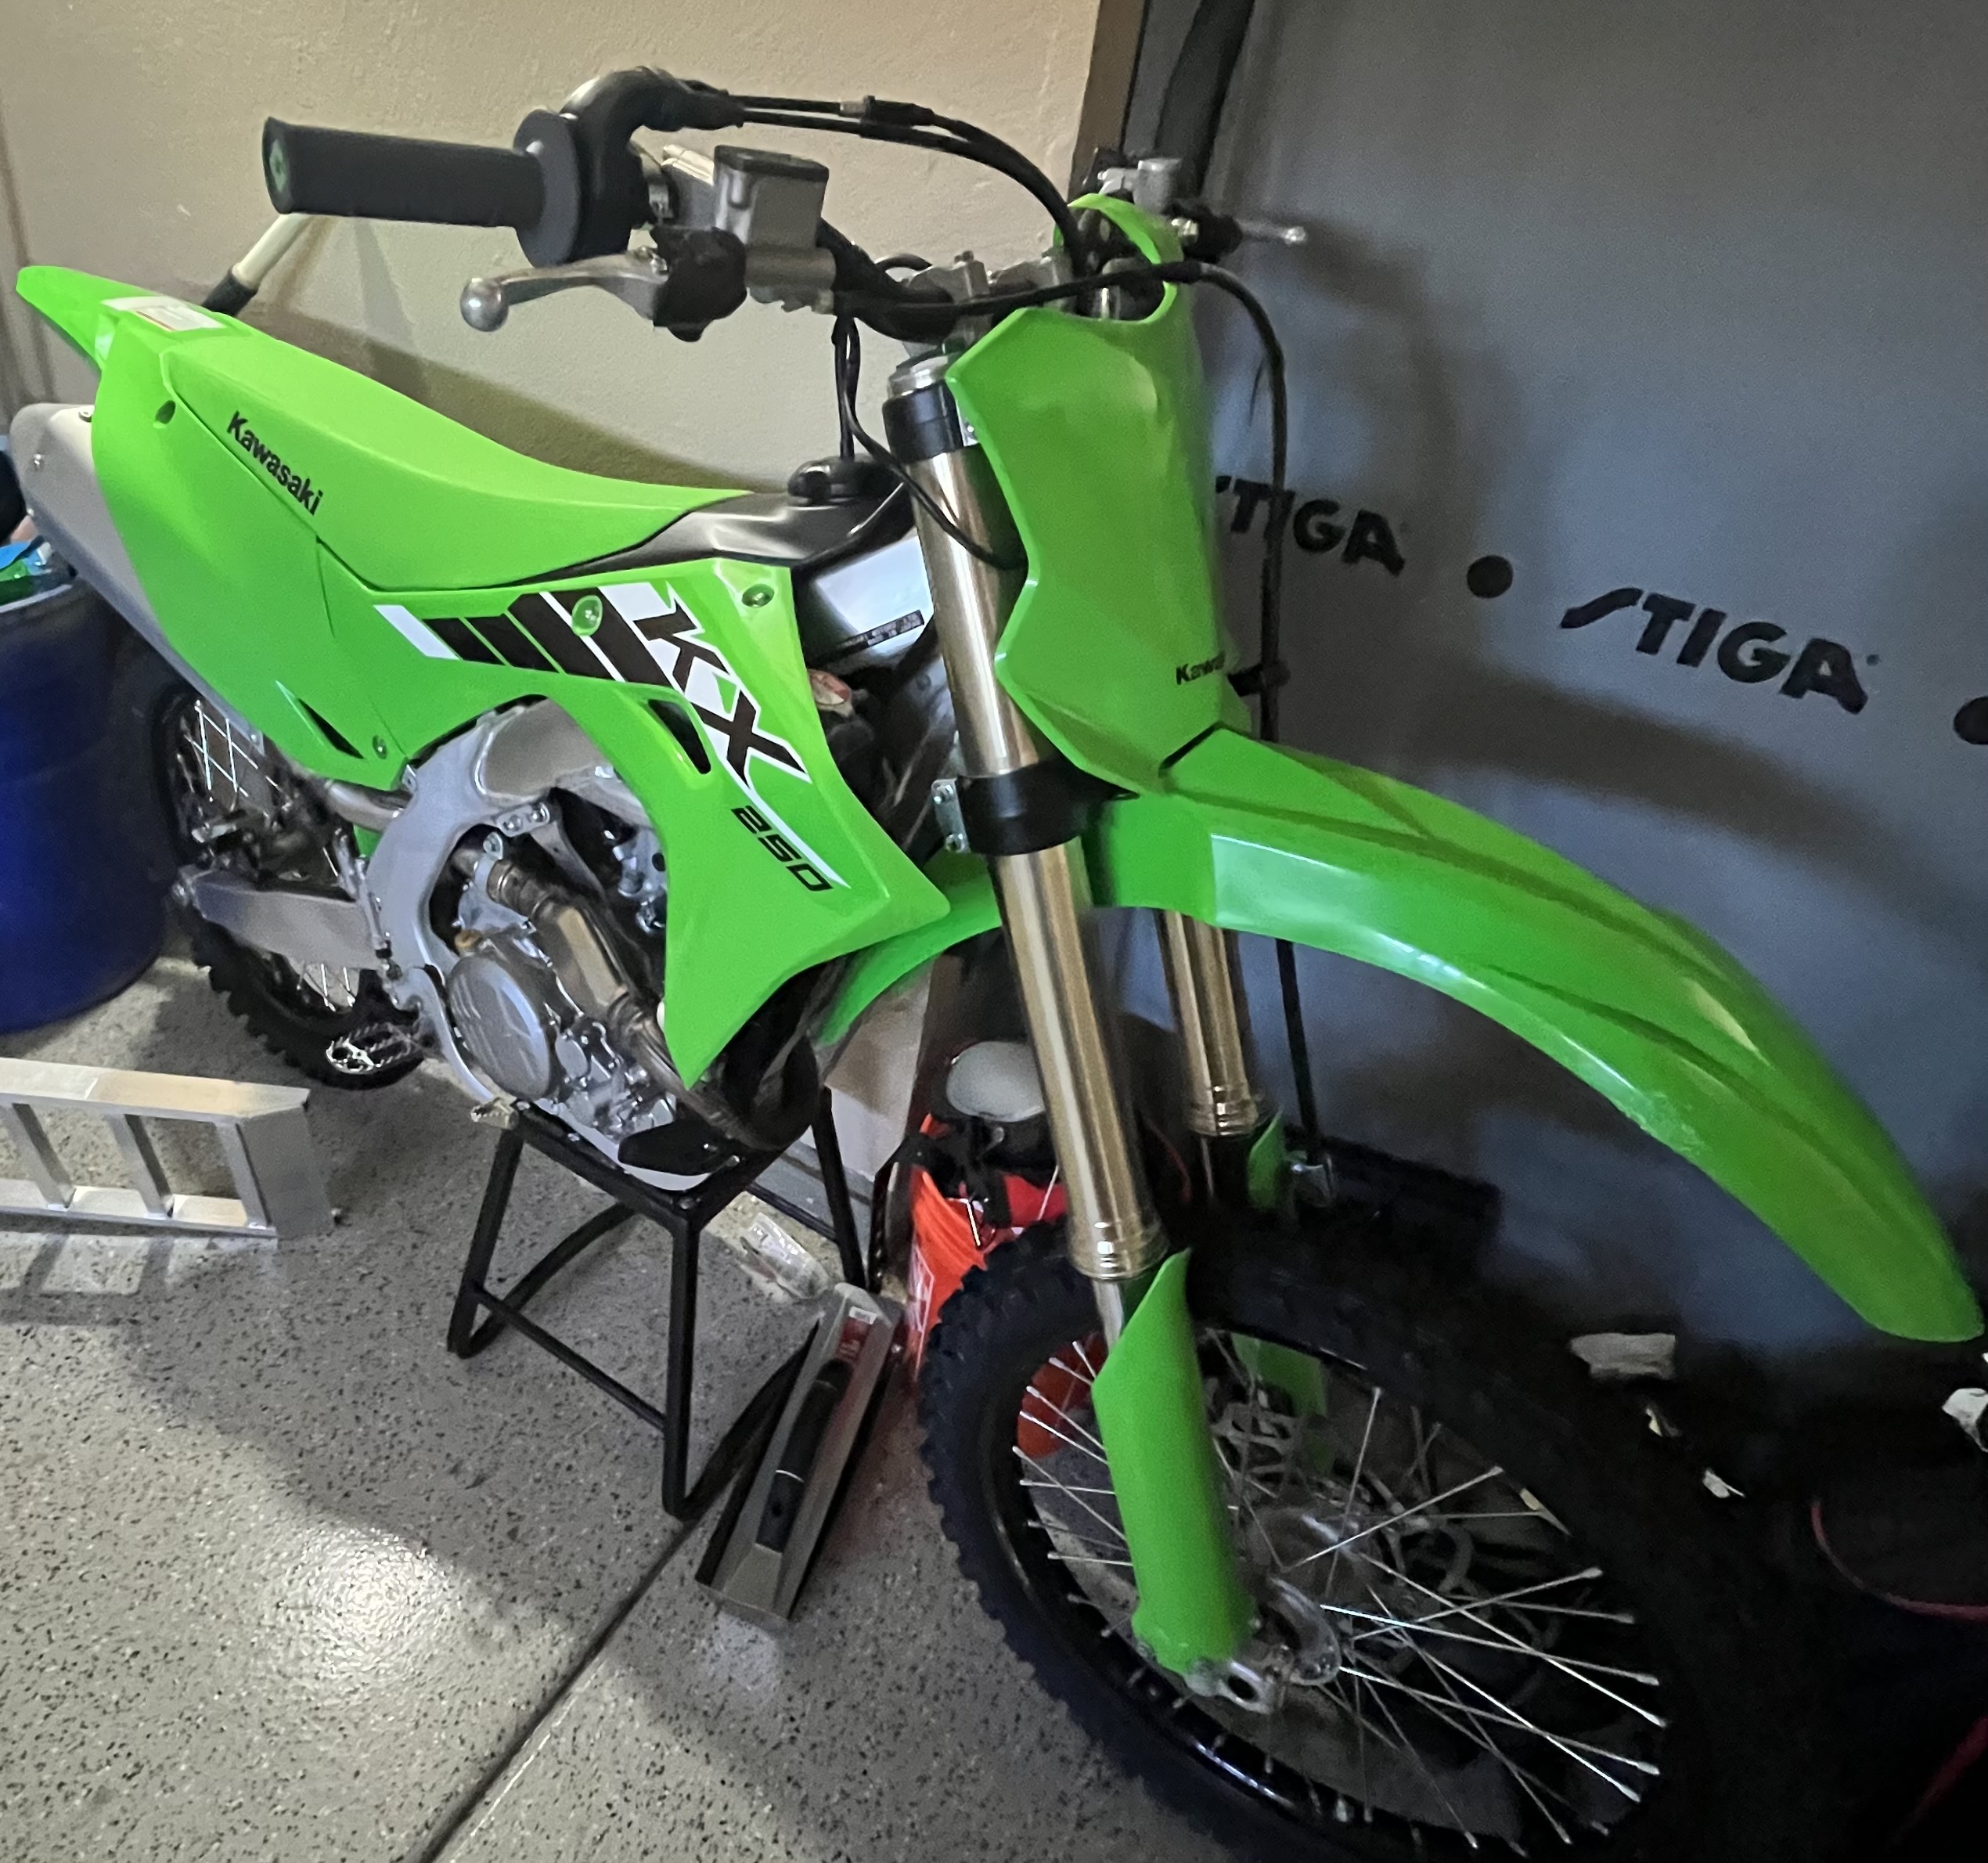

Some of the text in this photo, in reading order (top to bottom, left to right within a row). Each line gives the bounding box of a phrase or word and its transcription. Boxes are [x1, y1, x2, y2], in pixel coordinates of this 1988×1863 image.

[227, 410, 323, 516] Kawasaki
[1215, 475, 1406, 576] TIGA
[632, 593, 809, 787] KX
[1560, 587, 1869, 715] STIGA
[730, 805, 833, 892] 250
